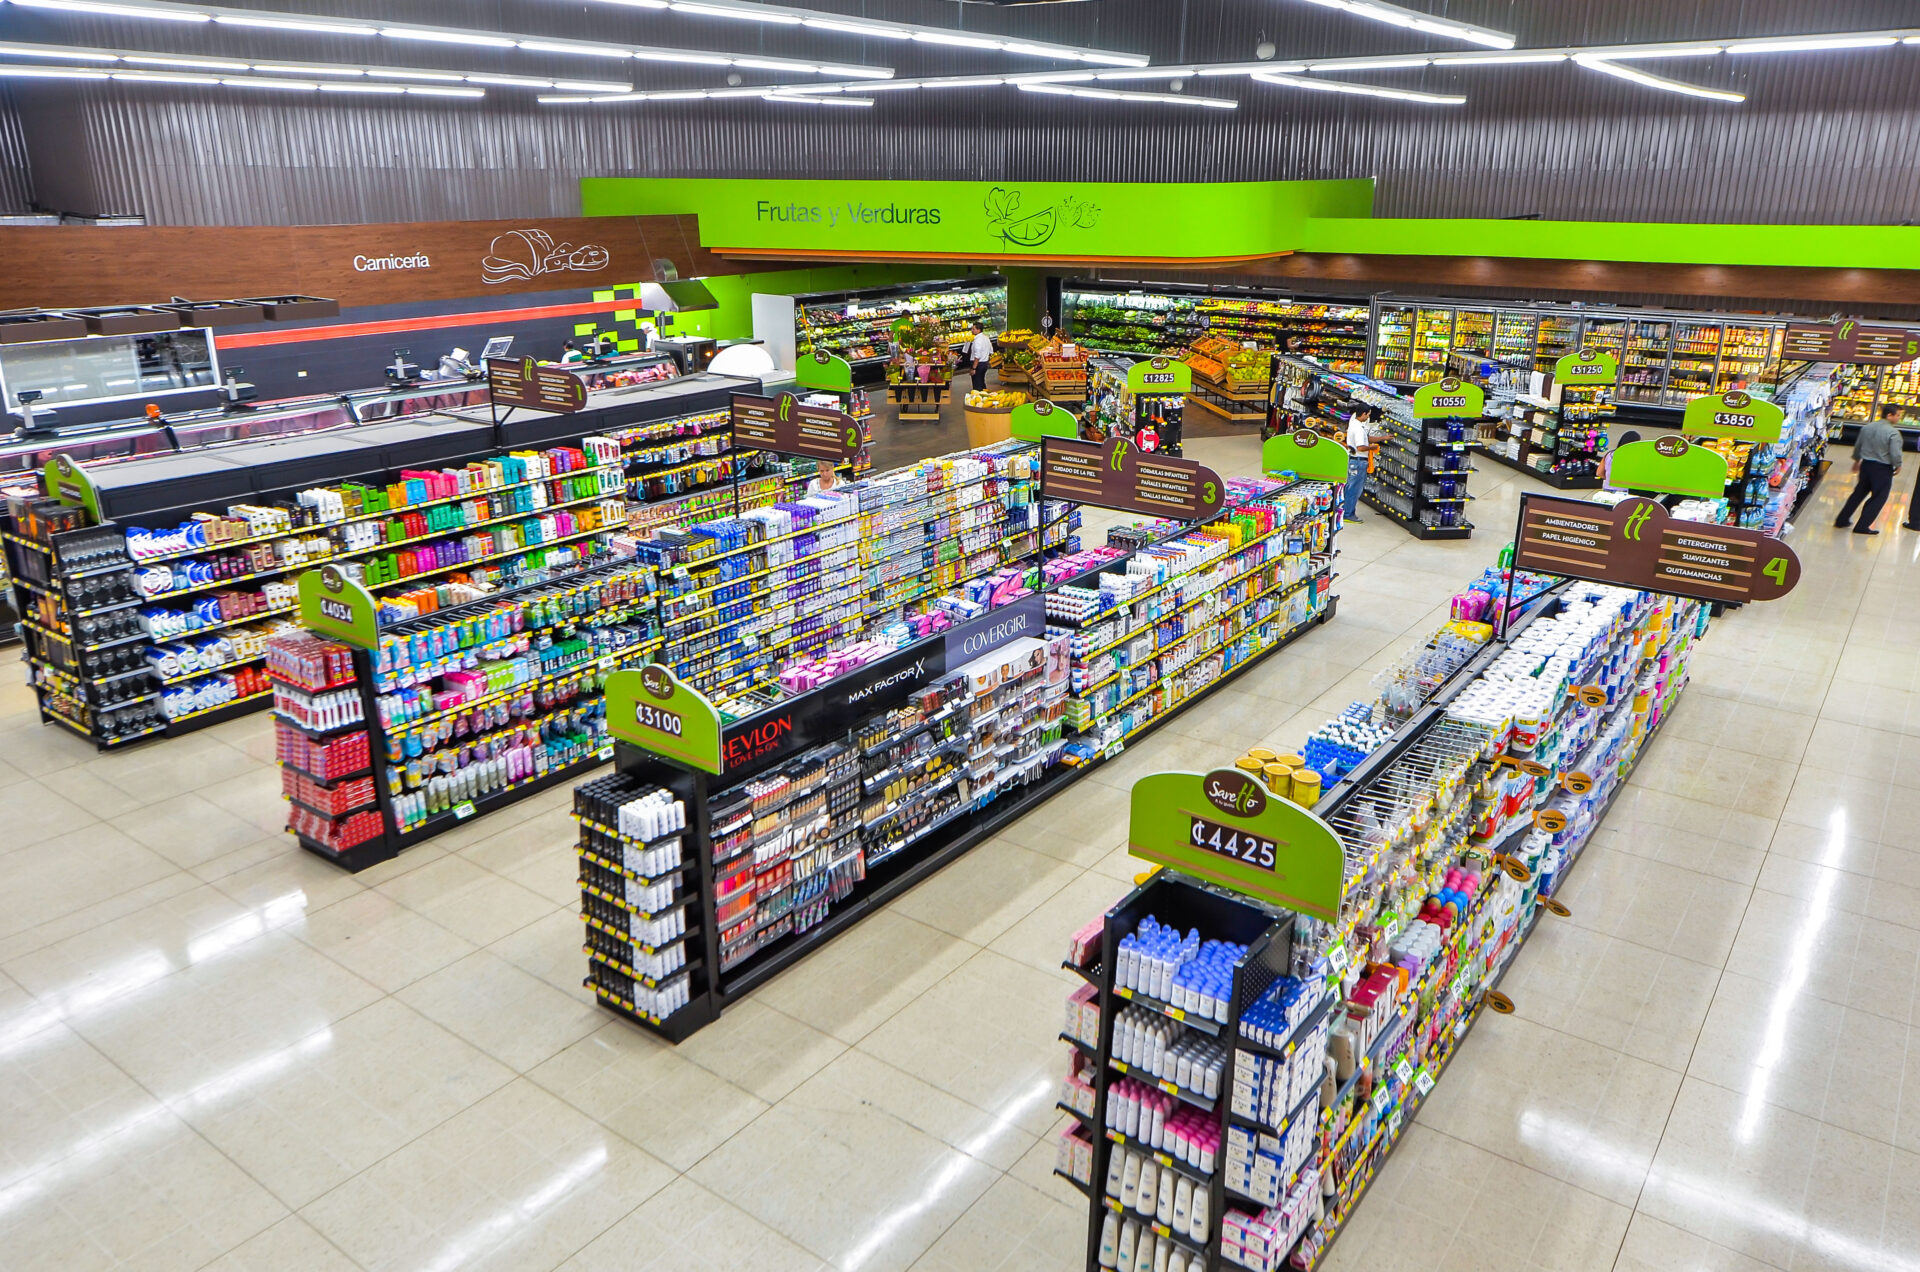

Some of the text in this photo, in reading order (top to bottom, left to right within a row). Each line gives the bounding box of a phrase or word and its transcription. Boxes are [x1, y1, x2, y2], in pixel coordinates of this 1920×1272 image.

[757, 200, 941, 227] Frutas y Verduras
[353, 251, 431, 272] Carnicería
[1906, 340, 1918, 355] 5
[575, 384, 582, 400] 1
[845, 427, 857, 448] 2
[1061, 455, 1088, 465] MAQUILLAJE
[1053, 465, 1073, 474] CUIDADO
[1087, 470, 1096, 478] PIEL
[1140, 466, 1189, 480] FÓRMULAS INFANTILES
[1141, 479, 1188, 492] PAÑALES INFANTILES
[1202, 481, 1217, 504] 3
[1141, 491, 1184, 504] TOALLAS HÚMEDAS
[1545, 518, 1599, 532] AMBIENTADORES
[1542, 532, 1596, 546] PAPEL HIGIÉNICO
[1677, 537, 1727, 551] DETERGENTES
[1682, 553, 1730, 567] SUAVIZANTES
[1665, 566, 1722, 581] QUITAMANCHAS
[1762, 557, 1789, 586] 4
[963, 613, 1030, 655] COVERGIRL
[848, 687, 873, 704] MAX
[874, 667, 915, 692] FACTOR
[730, 740, 779, 768] LOVE IS ON
[1208, 781, 1259, 814] Saretto
